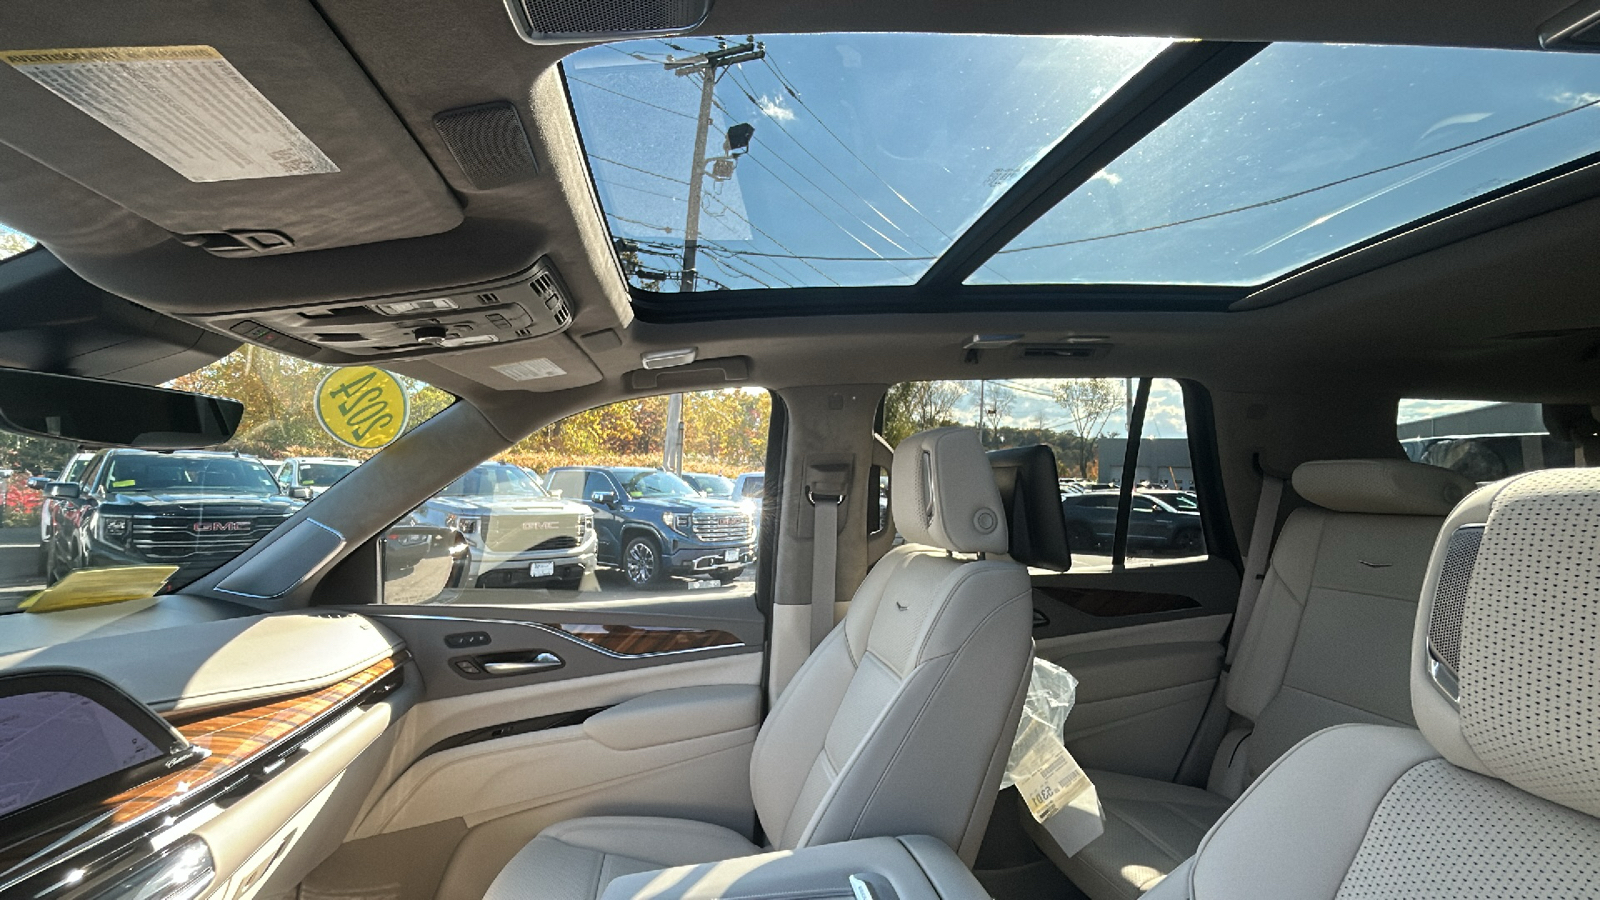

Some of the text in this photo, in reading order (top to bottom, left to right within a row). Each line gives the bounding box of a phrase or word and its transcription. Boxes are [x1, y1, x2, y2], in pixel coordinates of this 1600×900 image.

[522, 521, 560, 530] GMC
[718, 517, 742, 526] GMC
[193, 521, 251, 532] GMC
